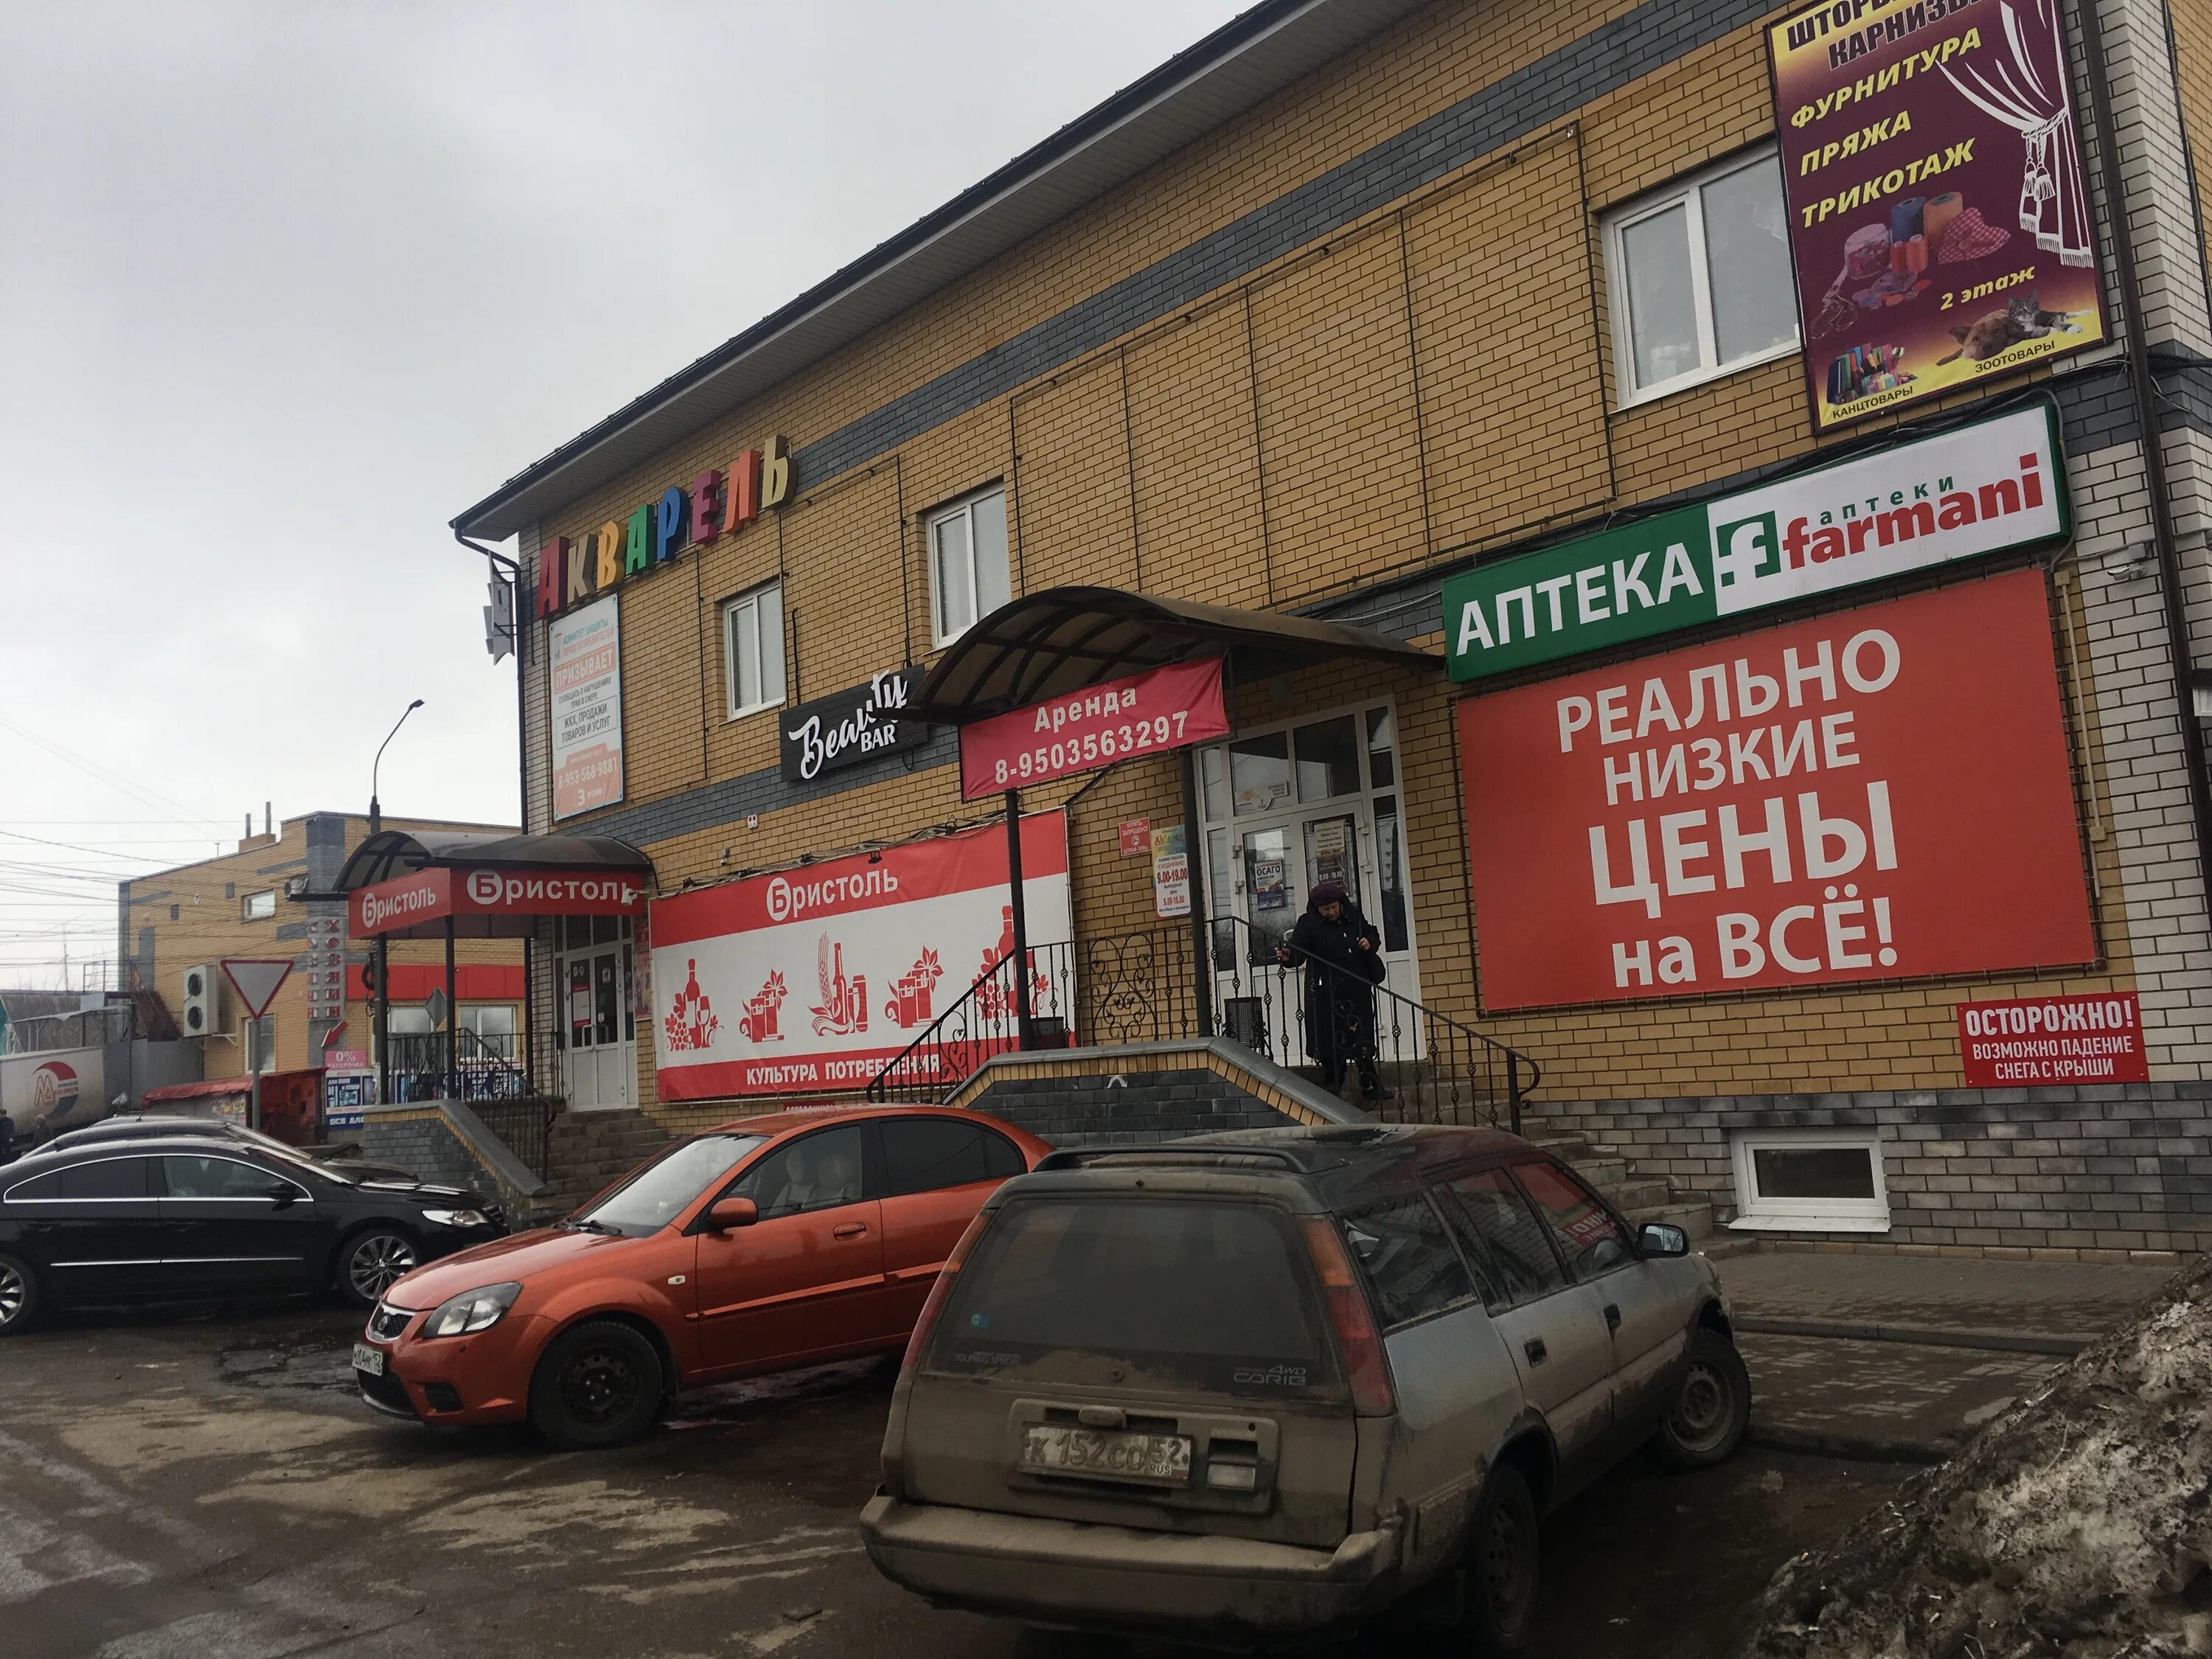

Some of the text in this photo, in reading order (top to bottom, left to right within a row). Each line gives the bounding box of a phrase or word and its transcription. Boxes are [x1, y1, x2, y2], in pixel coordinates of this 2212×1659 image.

[1790, 27, 1982, 129] ФУРНИТУРА
[1800, 110, 1912, 177] ПРЯЖА
[1801, 138, 1976, 229] ТРИКОТАЖ
[1940, 265, 2035, 310] 2 этаж
[1974, 340, 2056, 374] ЗООТОВАРЫ
[1832, 386, 1914, 420] КАНЦТОВАРЫ
[1782, 452, 2044, 571] farmani
[1820, 475, 1955, 526] аптеки
[537, 434, 798, 619] АКВАРЕЛЬ
[1455, 542, 1704, 658] АПТЕКА
[556, 649, 613, 689] ПРИЗЫВАЕТ
[1033, 687, 1137, 733] Аренда
[1556, 627, 1902, 754] РЕАЛЬНО
[561, 715, 611, 743] ТОВАРОВ И УСЛУГ
[578, 703, 608, 723] ПРОДАЖИ
[860, 723, 896, 753] BAR
[995, 711, 1189, 785] 8-9503563297
[1603, 711, 1860, 807] НИЗКИЕ
[577, 788, 585, 807] 3
[1587, 779, 1899, 920] ЦЕНЫ
[1157, 867, 1188, 884] 9.00-19.00
[1256, 865, 1281, 877] ОСАГО
[362, 886, 437, 928] Бристоль
[766, 868, 899, 922] Бристоль
[1612, 883, 1899, 990] на ВСЁ!
[1966, 1000, 2134, 1037] ОСТОРОЖНО!
[335, 1050, 356, 1062] 0%
[1972, 1035, 2134, 1060] ВОЗМОЖНО ПАДЕНИЕ
[745, 1052, 941, 1086] КУЛЬТУРА ПОТРЕБЛЕНИЯ
[1994, 1058, 2115, 1079] СНЕГА С КРЫШИ
[1268, 1364, 1306, 1375] 4WD
[1150, 1464, 1171, 1474] RUS
